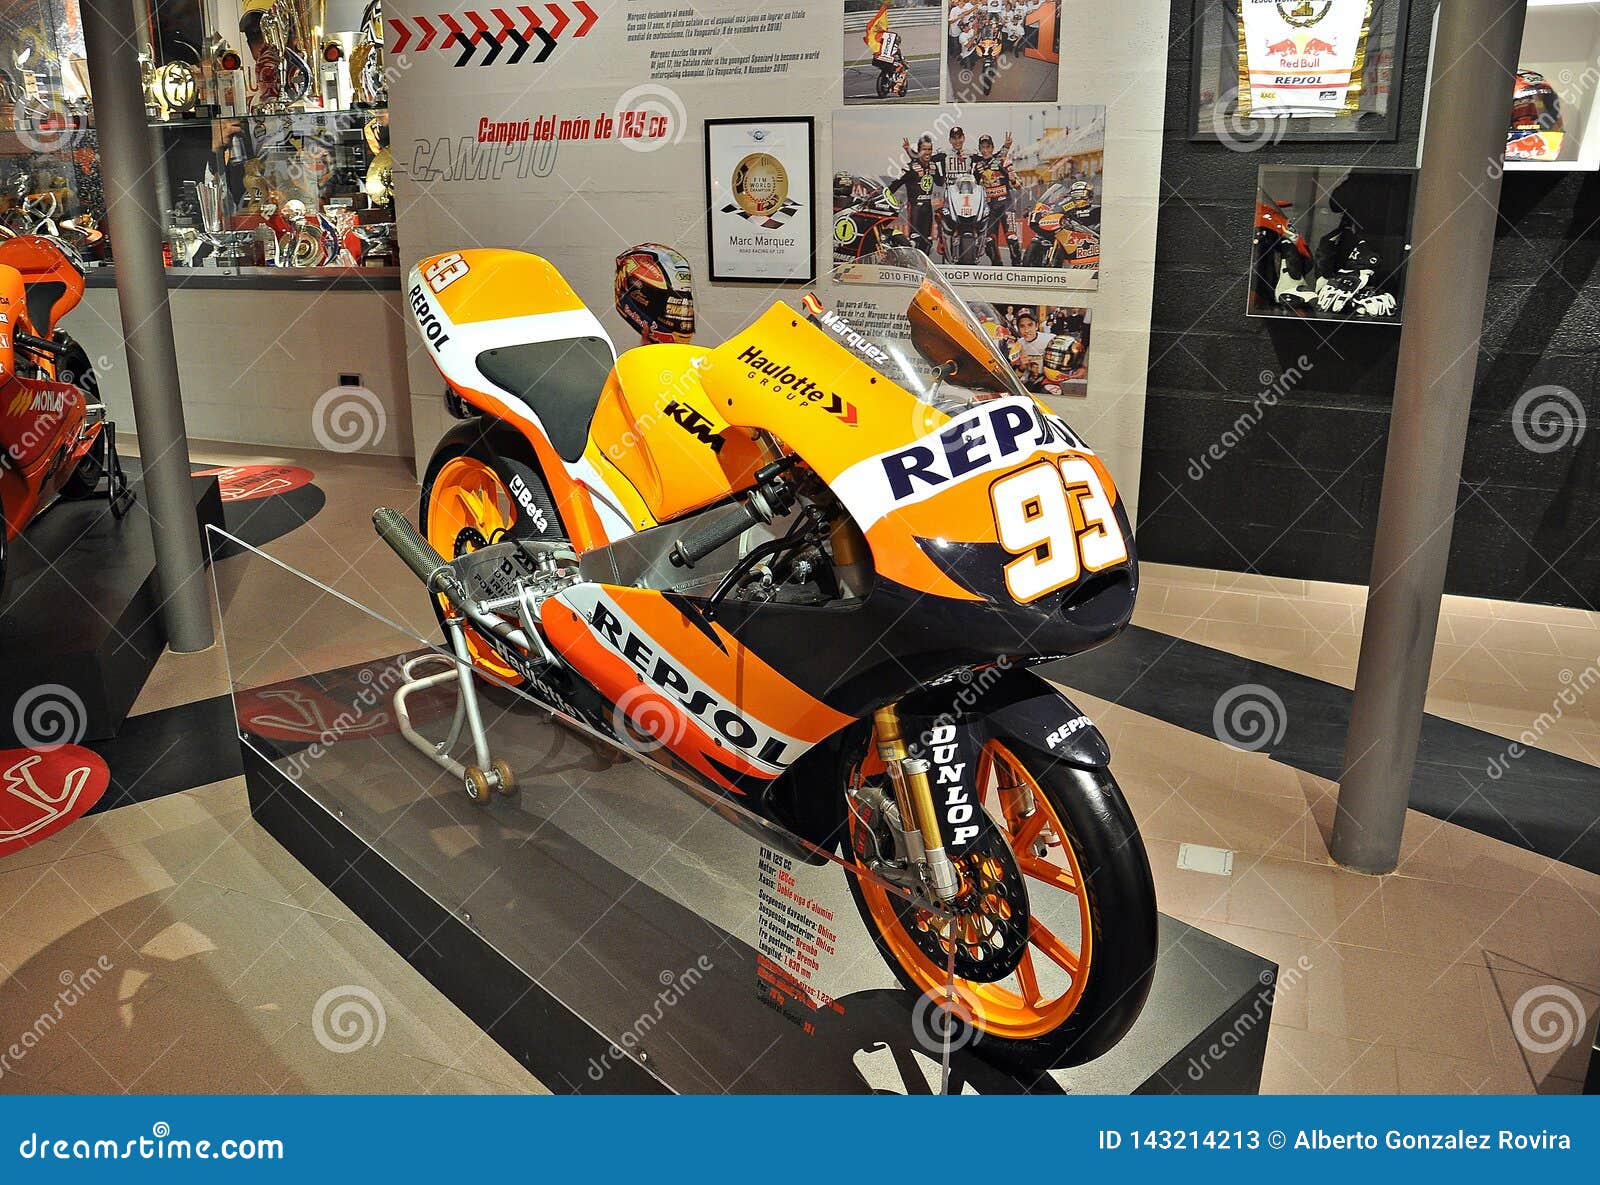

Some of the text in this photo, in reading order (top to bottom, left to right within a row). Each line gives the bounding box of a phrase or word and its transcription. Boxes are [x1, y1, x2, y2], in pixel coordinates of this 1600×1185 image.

[1275, 76, 1323, 84] REPSOL
[1280, 58, 1319, 68] Red Bull
[478, 112, 668, 146] Campió del món de 125 cc
[730, 236, 795, 248] Marc Marquez
[423, 253, 470, 295] 93
[880, 271, 1066, 284] 2010 FIM World Champions
[409, 284, 450, 353] REPSOL
[820, 310, 889, 365] Márquez
[737, 345, 825, 404] Haulotte
[748, 371, 809, 408] GROUP
[664, 400, 728, 458] KTM
[518, 484, 549, 534] Beta
[989, 456, 1127, 604] 93
[592, 600, 791, 767] REPSOL
[928, 724, 979, 846] DUNLOP
[759, 859, 777, 878] Motor:
[760, 846, 772, 860] KTM
[773, 852, 783, 867] 125
[787, 906, 818, 931] davantera:
[787, 920, 815, 944] posterior:
[759, 939, 782, 962] Longitud:
[768, 920, 795, 944] davanter:
[796, 936, 818, 956] Brembo
[768, 934, 796, 958] posterior:
[797, 950, 819, 971] Brembo
